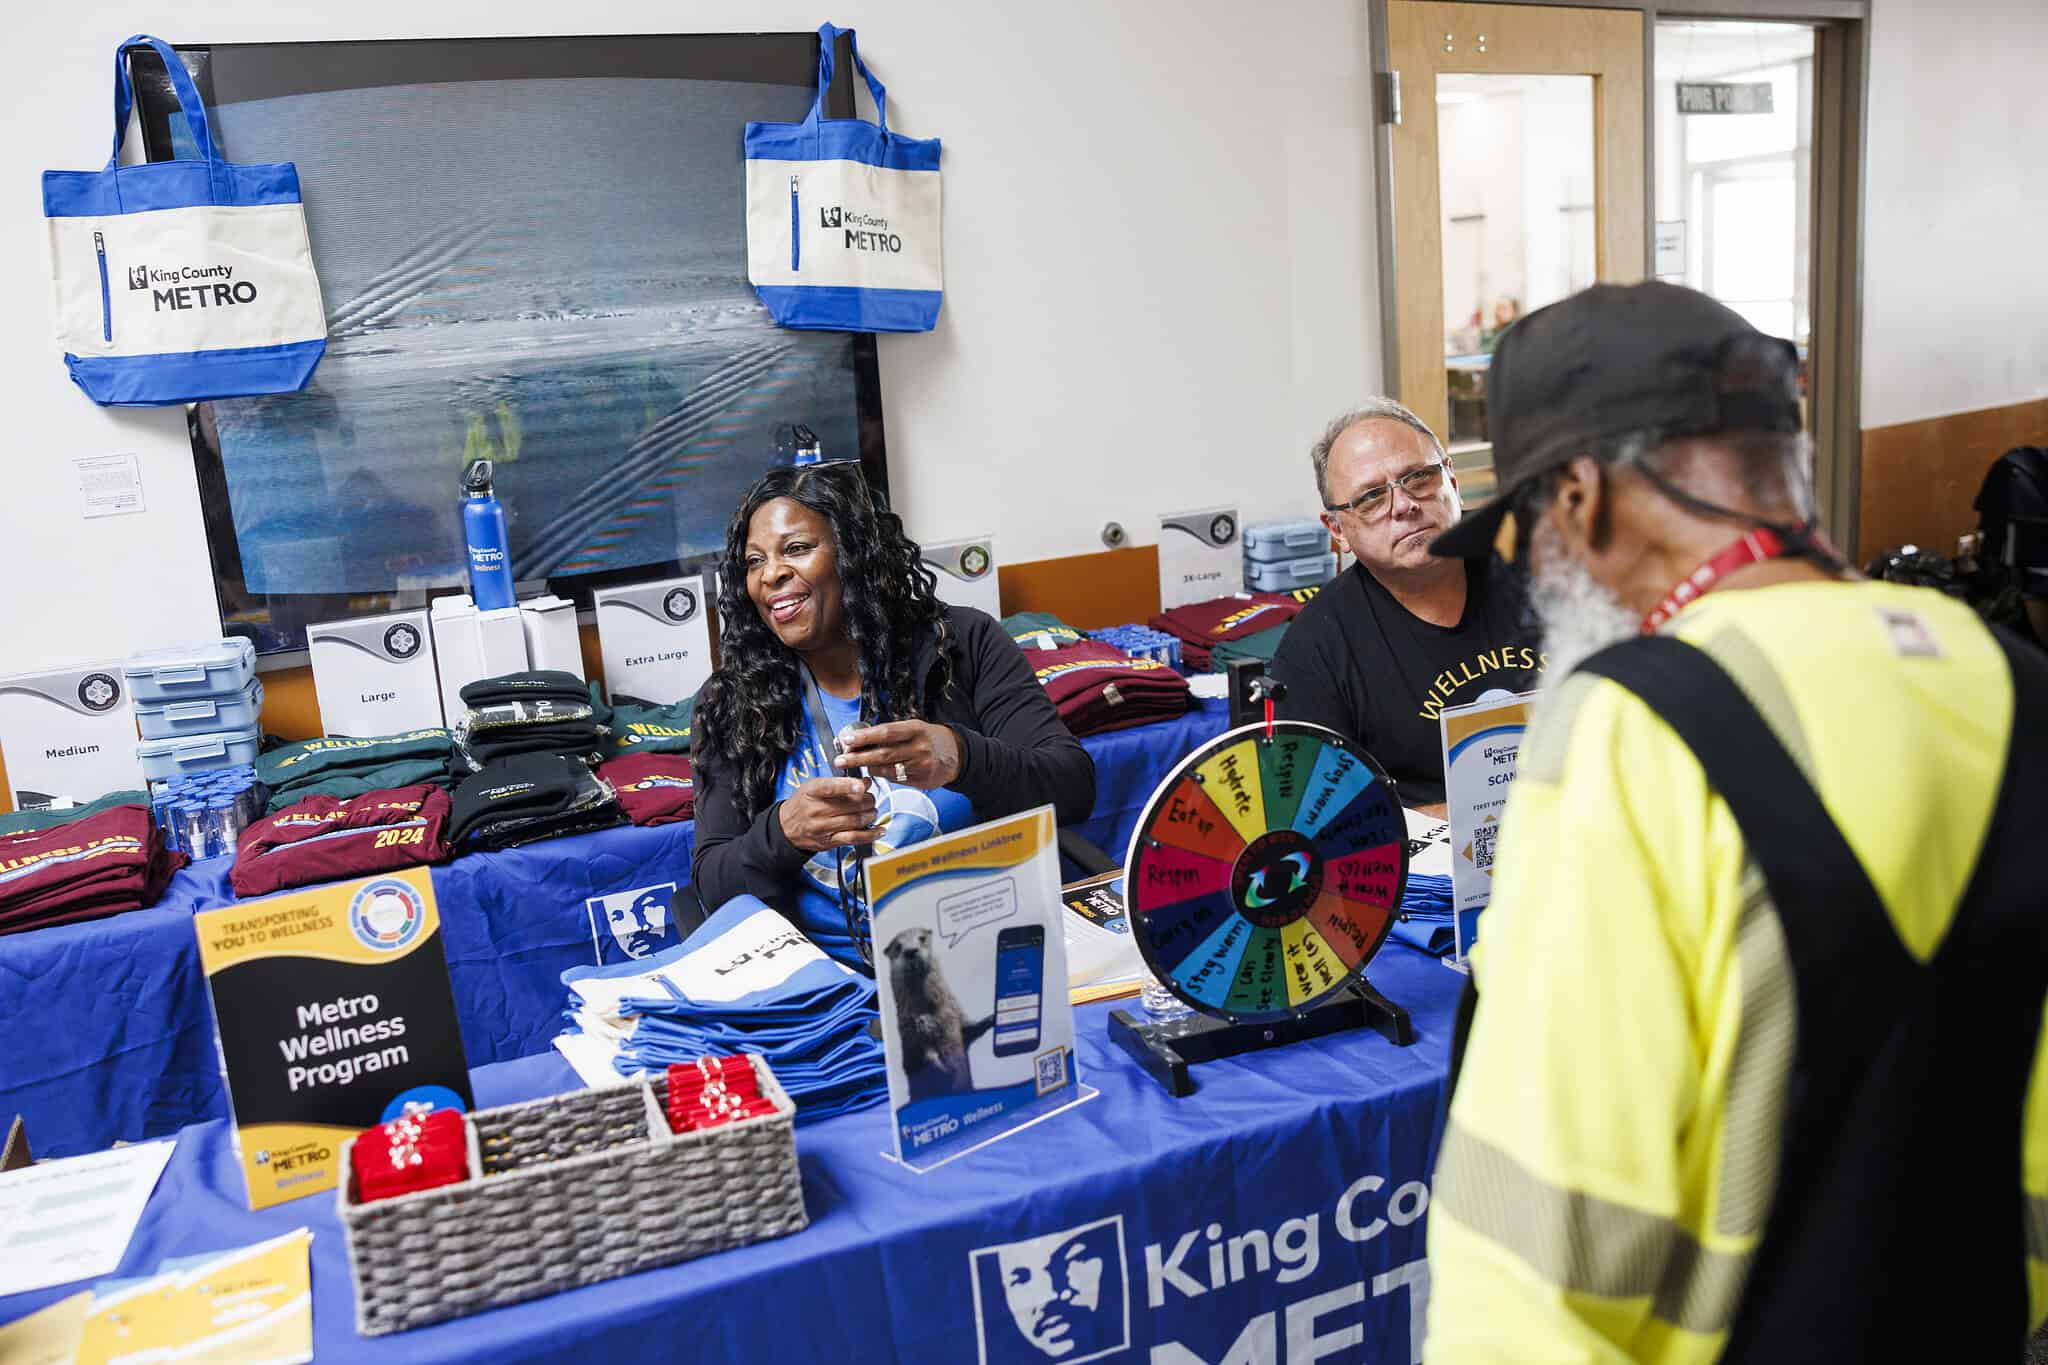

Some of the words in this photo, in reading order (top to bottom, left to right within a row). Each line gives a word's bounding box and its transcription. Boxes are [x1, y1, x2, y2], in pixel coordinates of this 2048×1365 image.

[845, 229, 902, 253] METRO
[150, 269, 180, 284] King
[181, 264, 233, 280] County
[153, 281, 257, 312] METRO
[472, 551, 504, 562] METRO
[625, 653, 656, 668] Extra
[657, 649, 689, 664] Large
[361, 690, 397, 704] Large
[1418, 646, 1550, 721] WELLNESS
[45, 742, 101, 760] Medium
[1493, 752, 1520, 766] METR
[1218, 753, 1253, 818] Hydrate
[1488, 768, 1517, 787] SCAN
[1168, 797, 1198, 825] Eat
[374, 827, 426, 849] 2024
[211, 935, 245, 951] YOU
[249, 930, 266, 943] TO
[270, 915, 334, 939] WELLNESS
[222, 904, 320, 935] TRANSPORTING
[1186, 959, 1226, 994] Stay
[296, 992, 379, 1030] Metro
[278, 1016, 407, 1063] Wellness
[287, 1045, 409, 1092] Program
[913, 1118, 959, 1148] METRO
[273, 1147, 331, 1174] METRO
[1145, 1212, 1320, 1309] King
[1335, 1174, 1434, 1243] Co
[1149, 1257, 1432, 1365] MET
